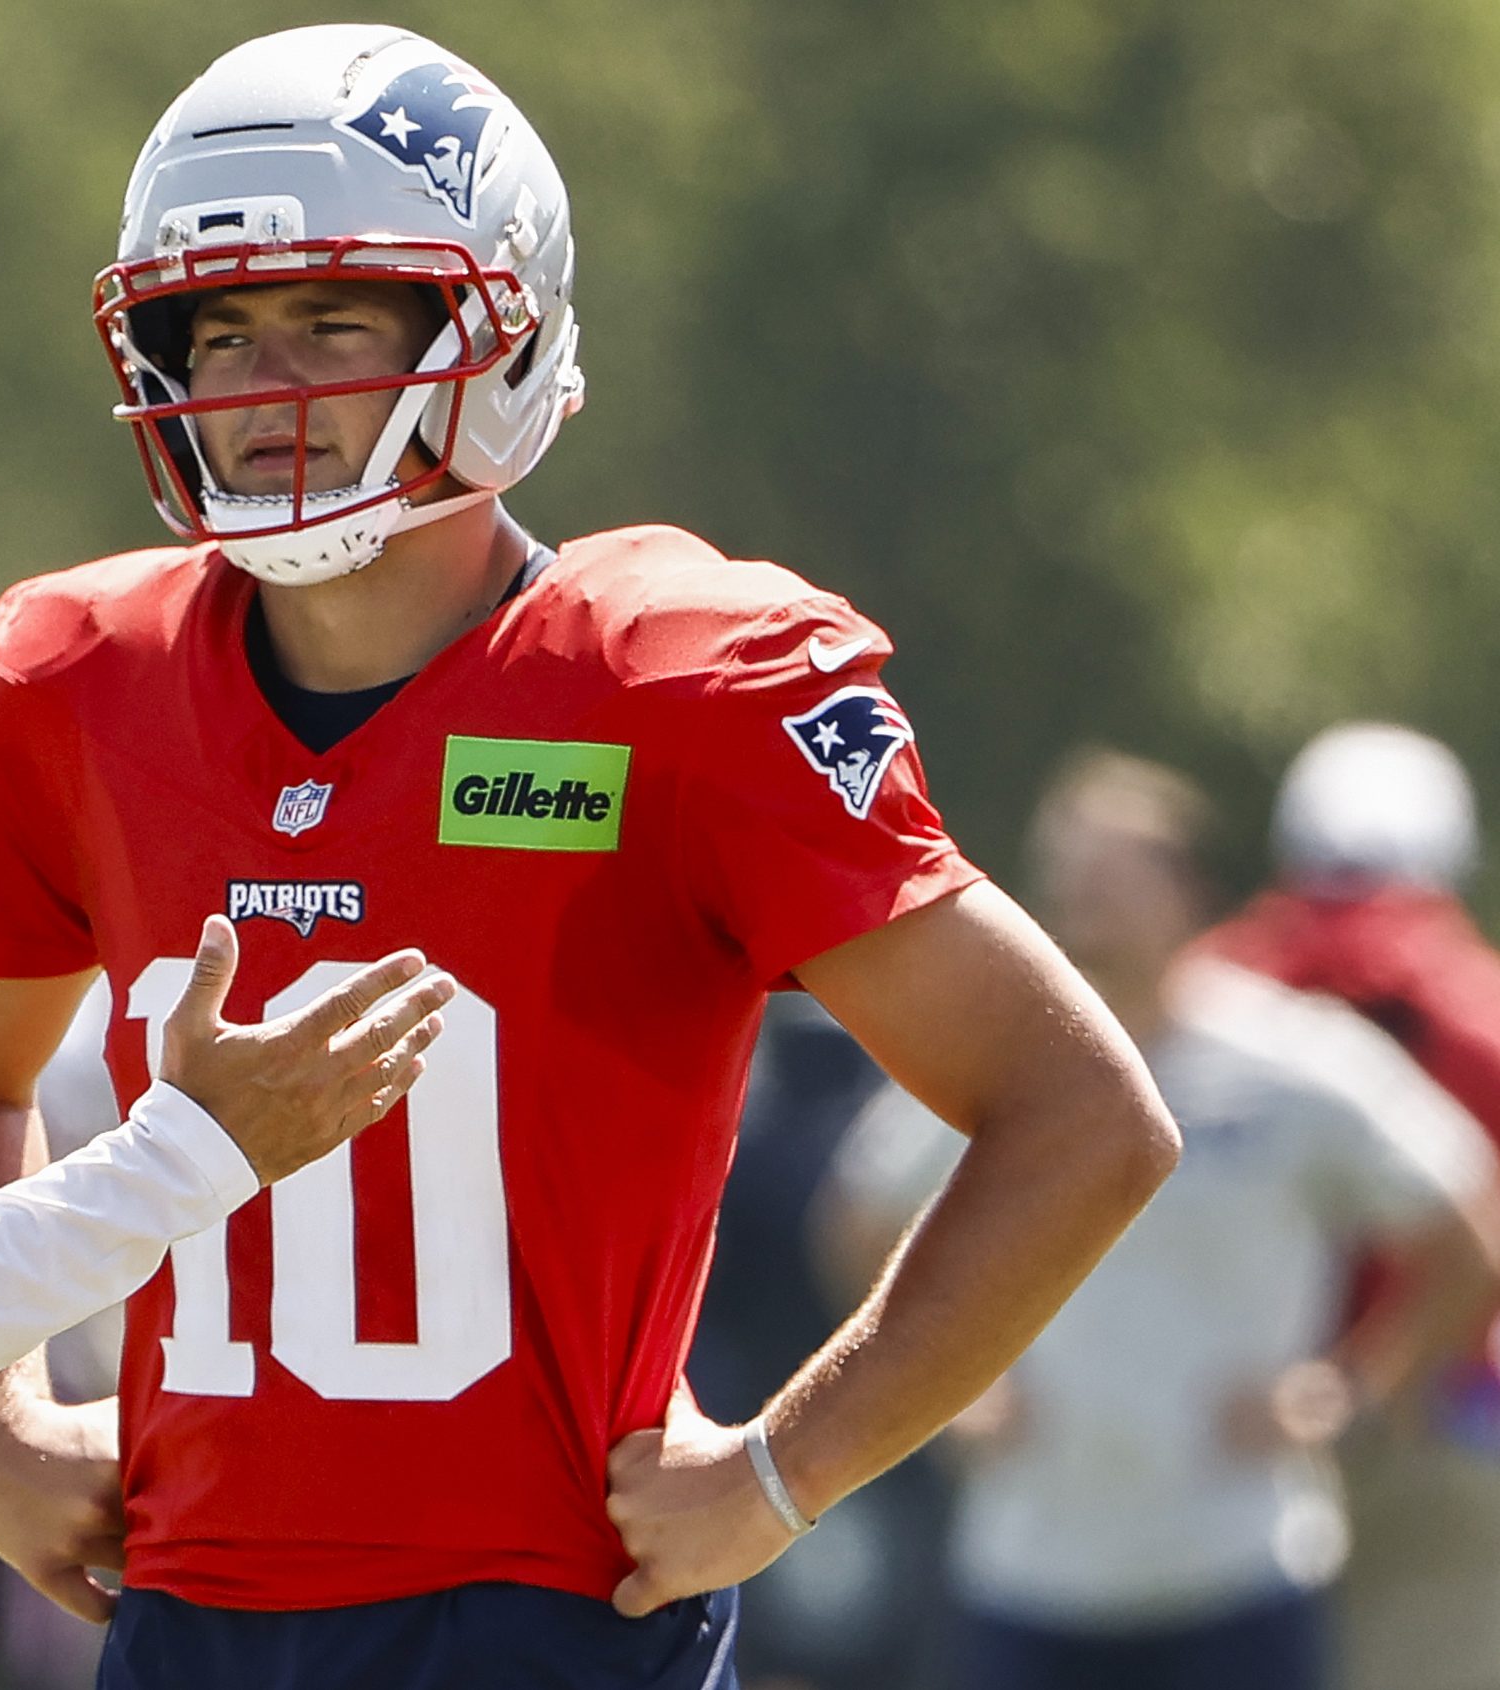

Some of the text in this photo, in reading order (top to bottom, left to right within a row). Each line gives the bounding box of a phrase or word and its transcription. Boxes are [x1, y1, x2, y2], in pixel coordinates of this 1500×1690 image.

[281, 802, 314, 823] NFL
[453, 772, 611, 822] Gillette
[230, 883, 360, 921] PATRIOTS
[126, 957, 512, 1401] 10
